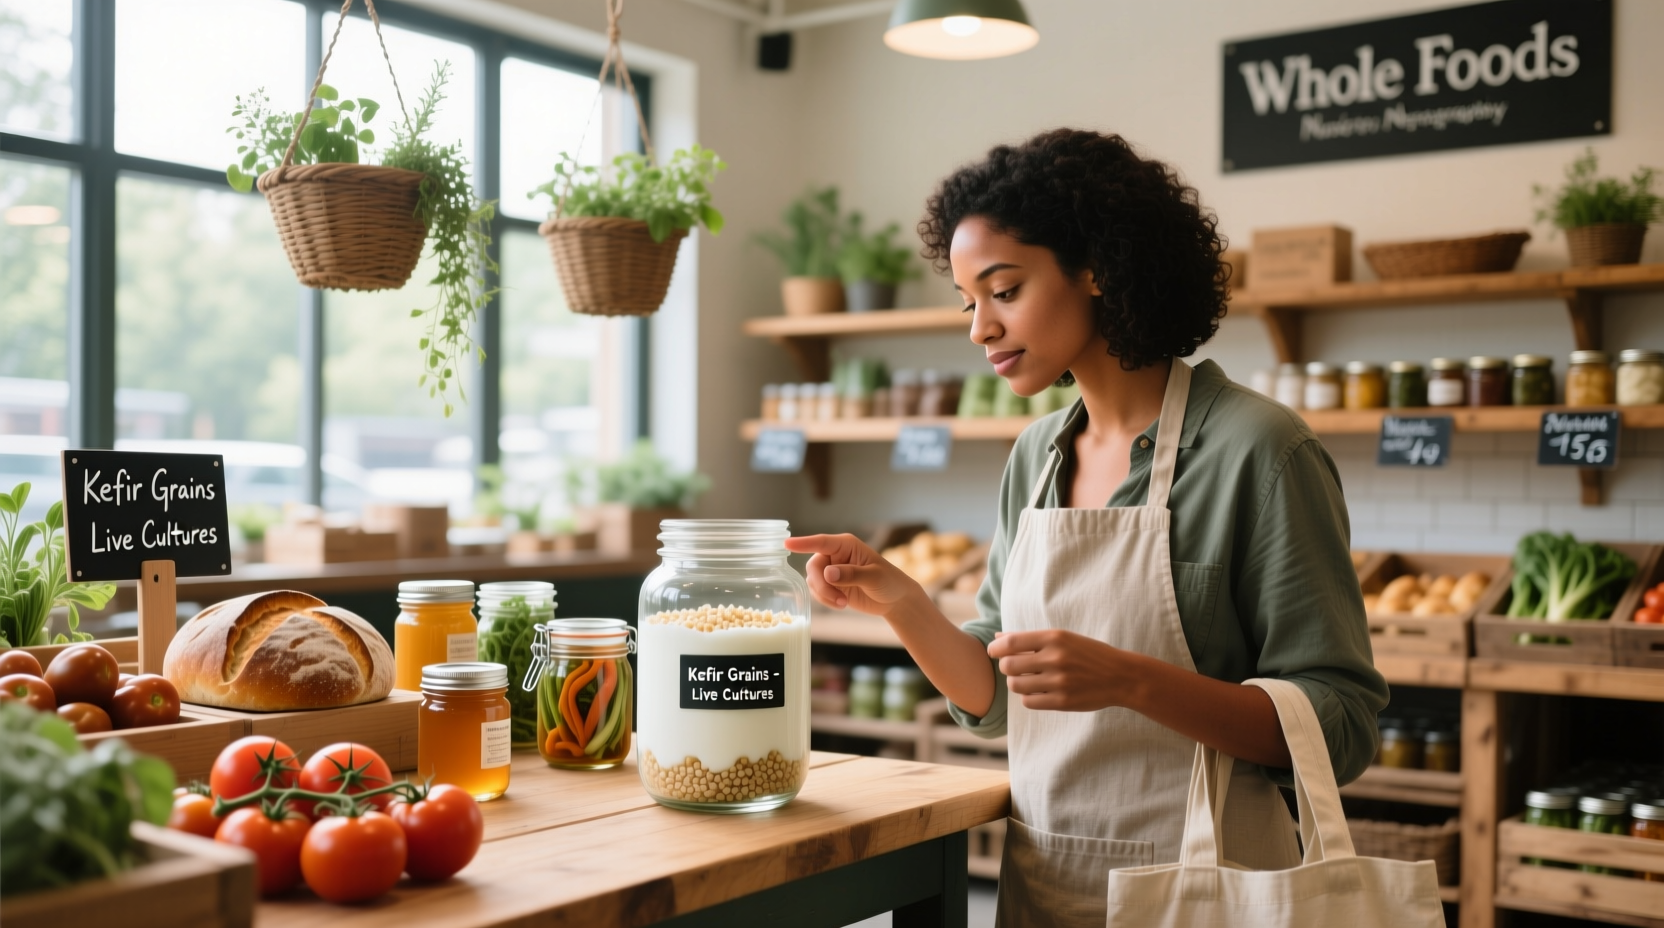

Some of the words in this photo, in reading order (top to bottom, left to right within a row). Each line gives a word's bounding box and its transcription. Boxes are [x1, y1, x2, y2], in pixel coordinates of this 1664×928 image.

[1240, 45, 1404, 116] Whole
[1414, 20, 1580, 96] Foods
[84, 468, 143, 506] Kefir
[151, 468, 215, 512] Grains
[91, 521, 134, 553] Live
[141, 519, 217, 548] Cultures
[688, 666, 724, 682] Kefir
[727, 666, 769, 682] Grains
[692, 687, 718, 701] Live
